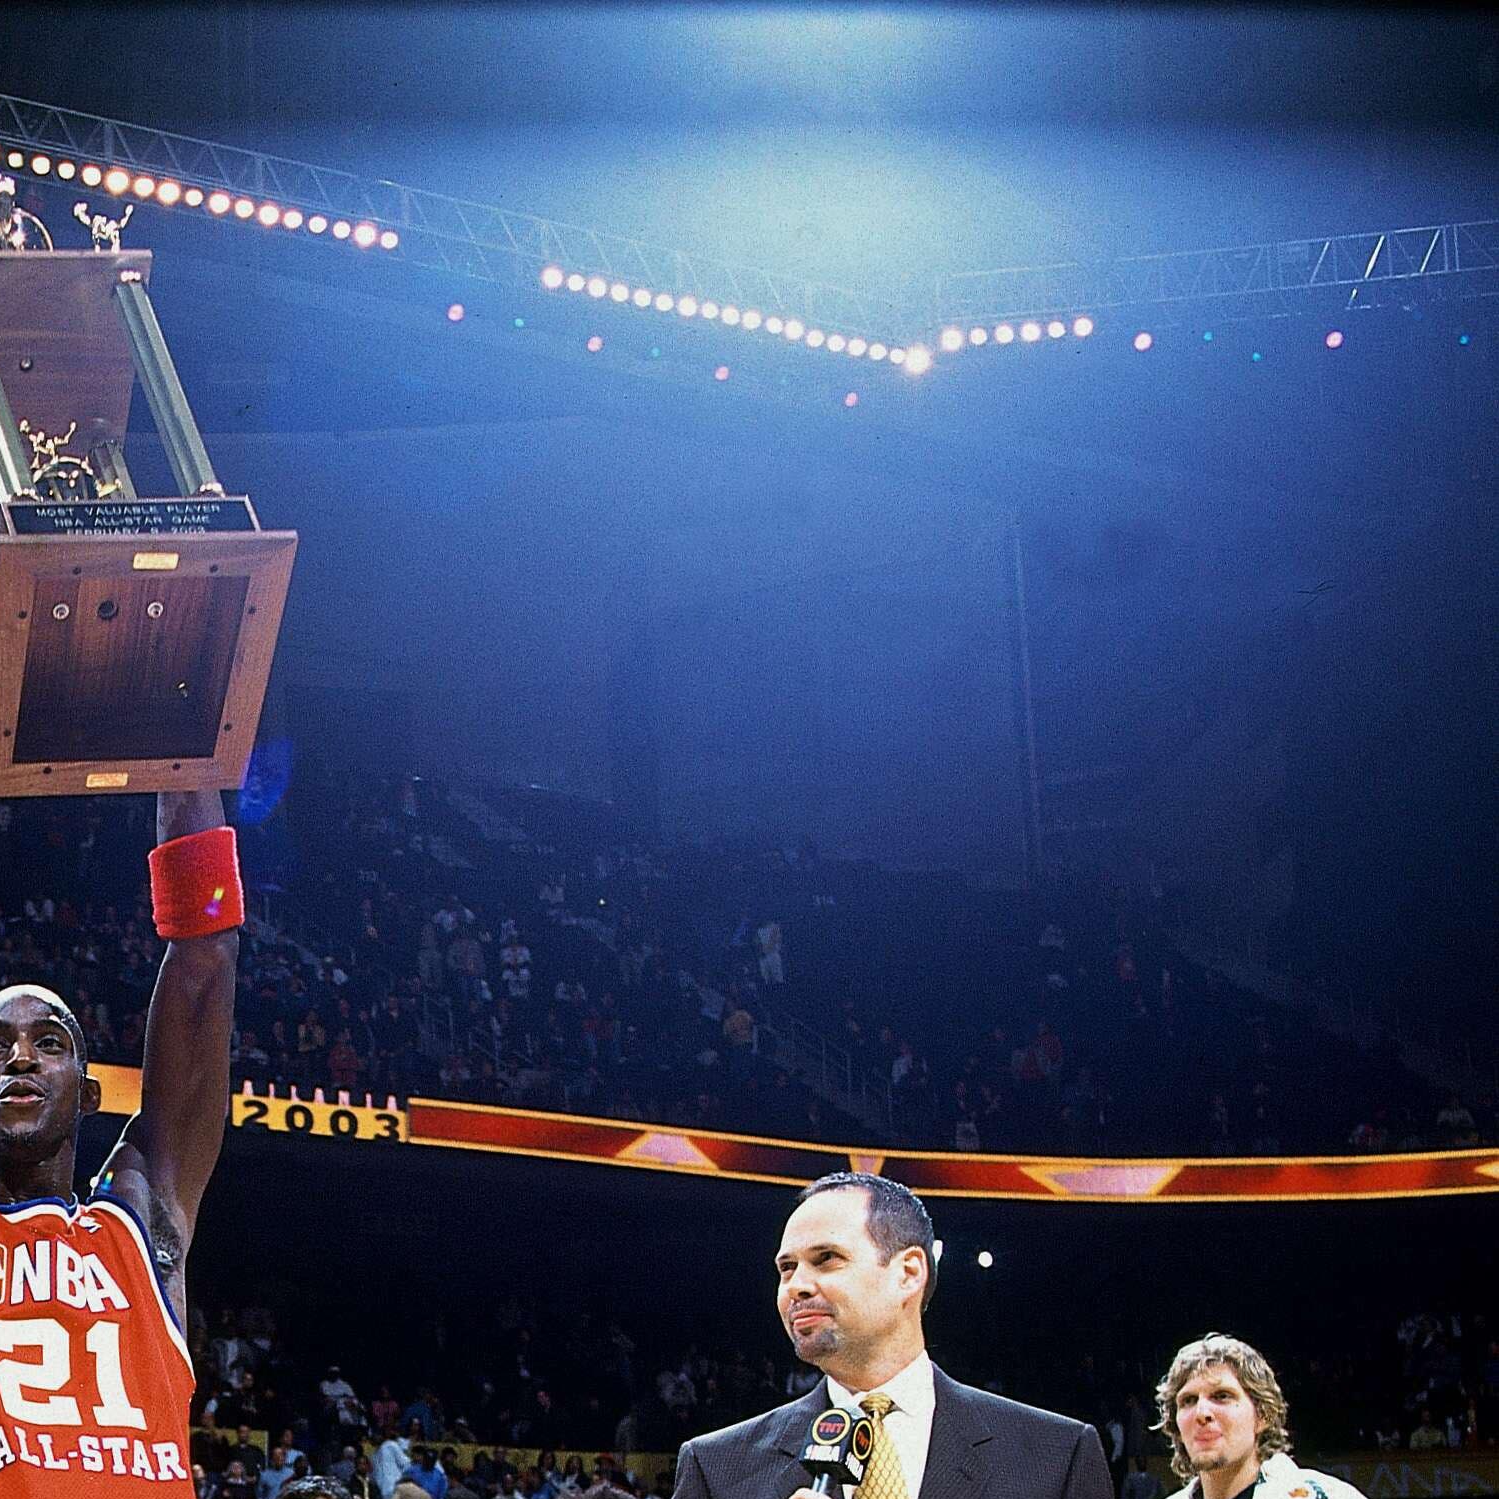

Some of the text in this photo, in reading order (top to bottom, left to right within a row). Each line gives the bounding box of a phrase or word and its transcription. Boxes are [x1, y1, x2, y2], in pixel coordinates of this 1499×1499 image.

[84, 505, 159, 517] VALUABLE
[166, 503, 221, 515] PLAYER
[242, 1099, 400, 1144] 2003
[10, 1239, 130, 1313] NBA
